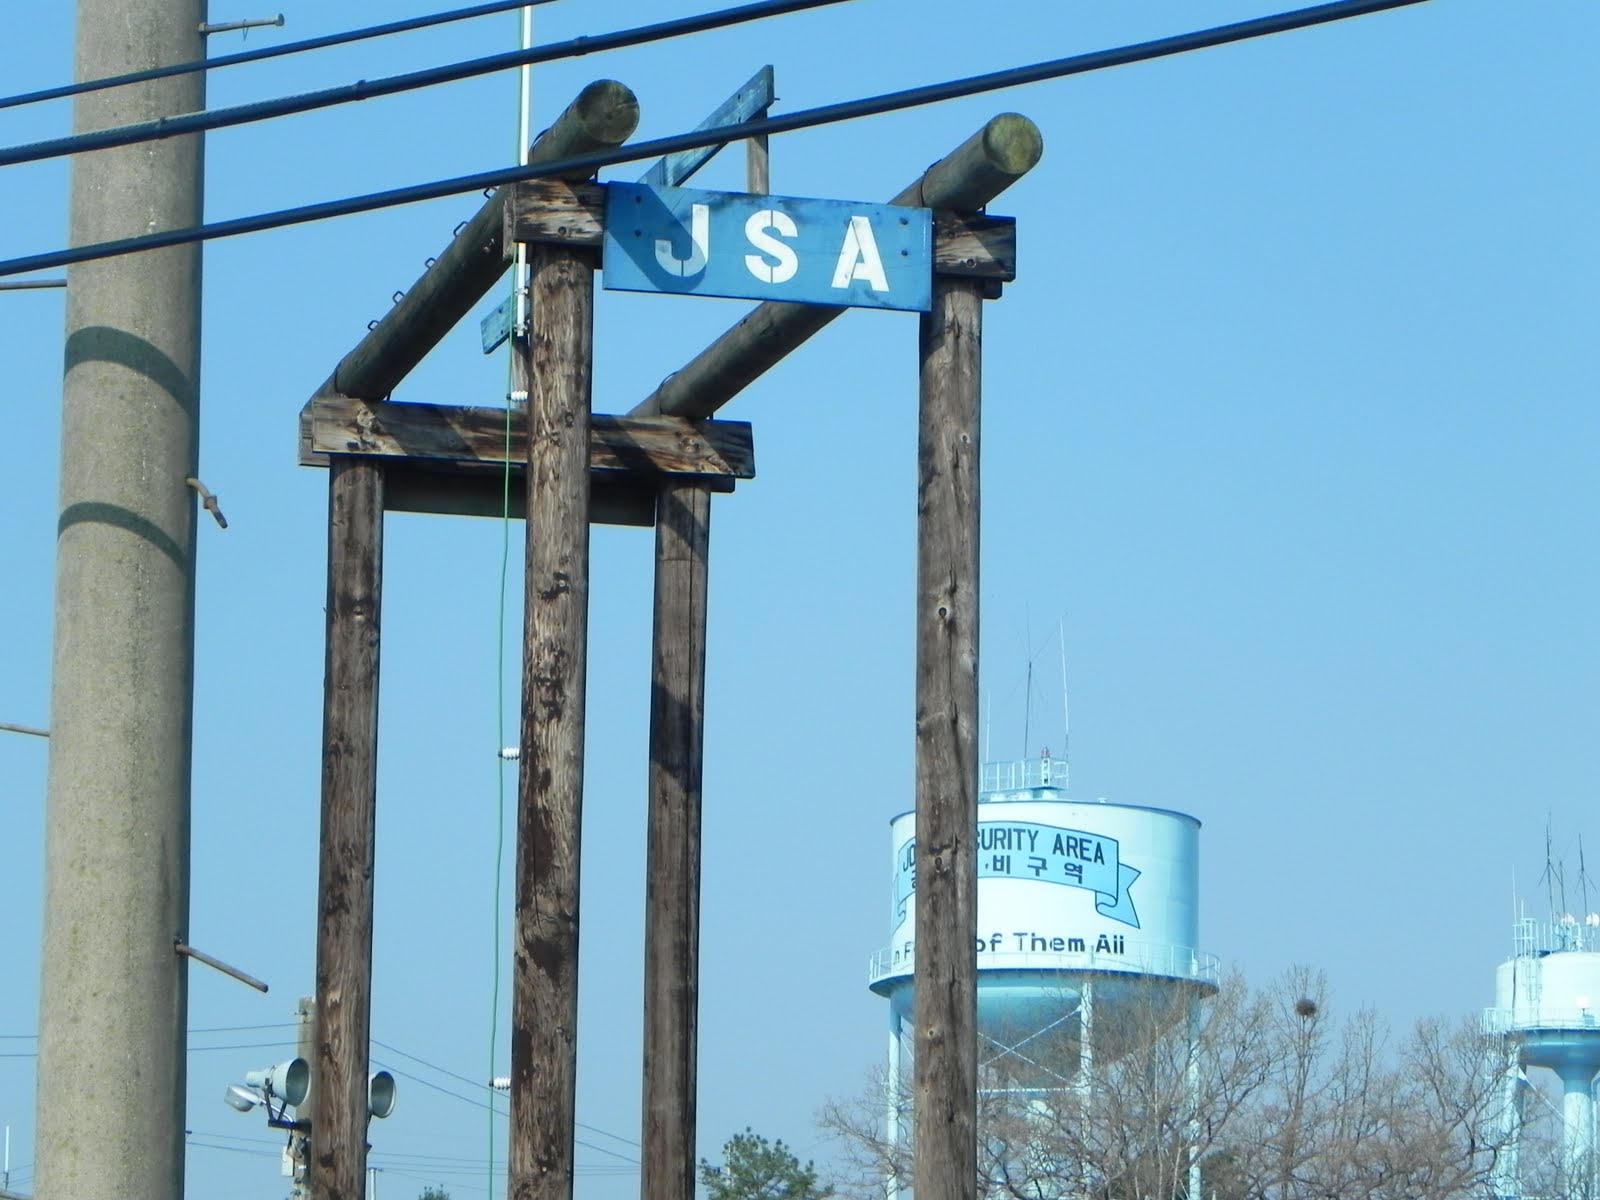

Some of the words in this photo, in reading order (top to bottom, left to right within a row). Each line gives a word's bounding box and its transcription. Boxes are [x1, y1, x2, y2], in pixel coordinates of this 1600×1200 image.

[976, 827, 1040, 853] URITY
[1052, 833, 1105, 866] AREA
[975, 932, 1003, 952] of
[1013, 932, 1086, 952] Them
